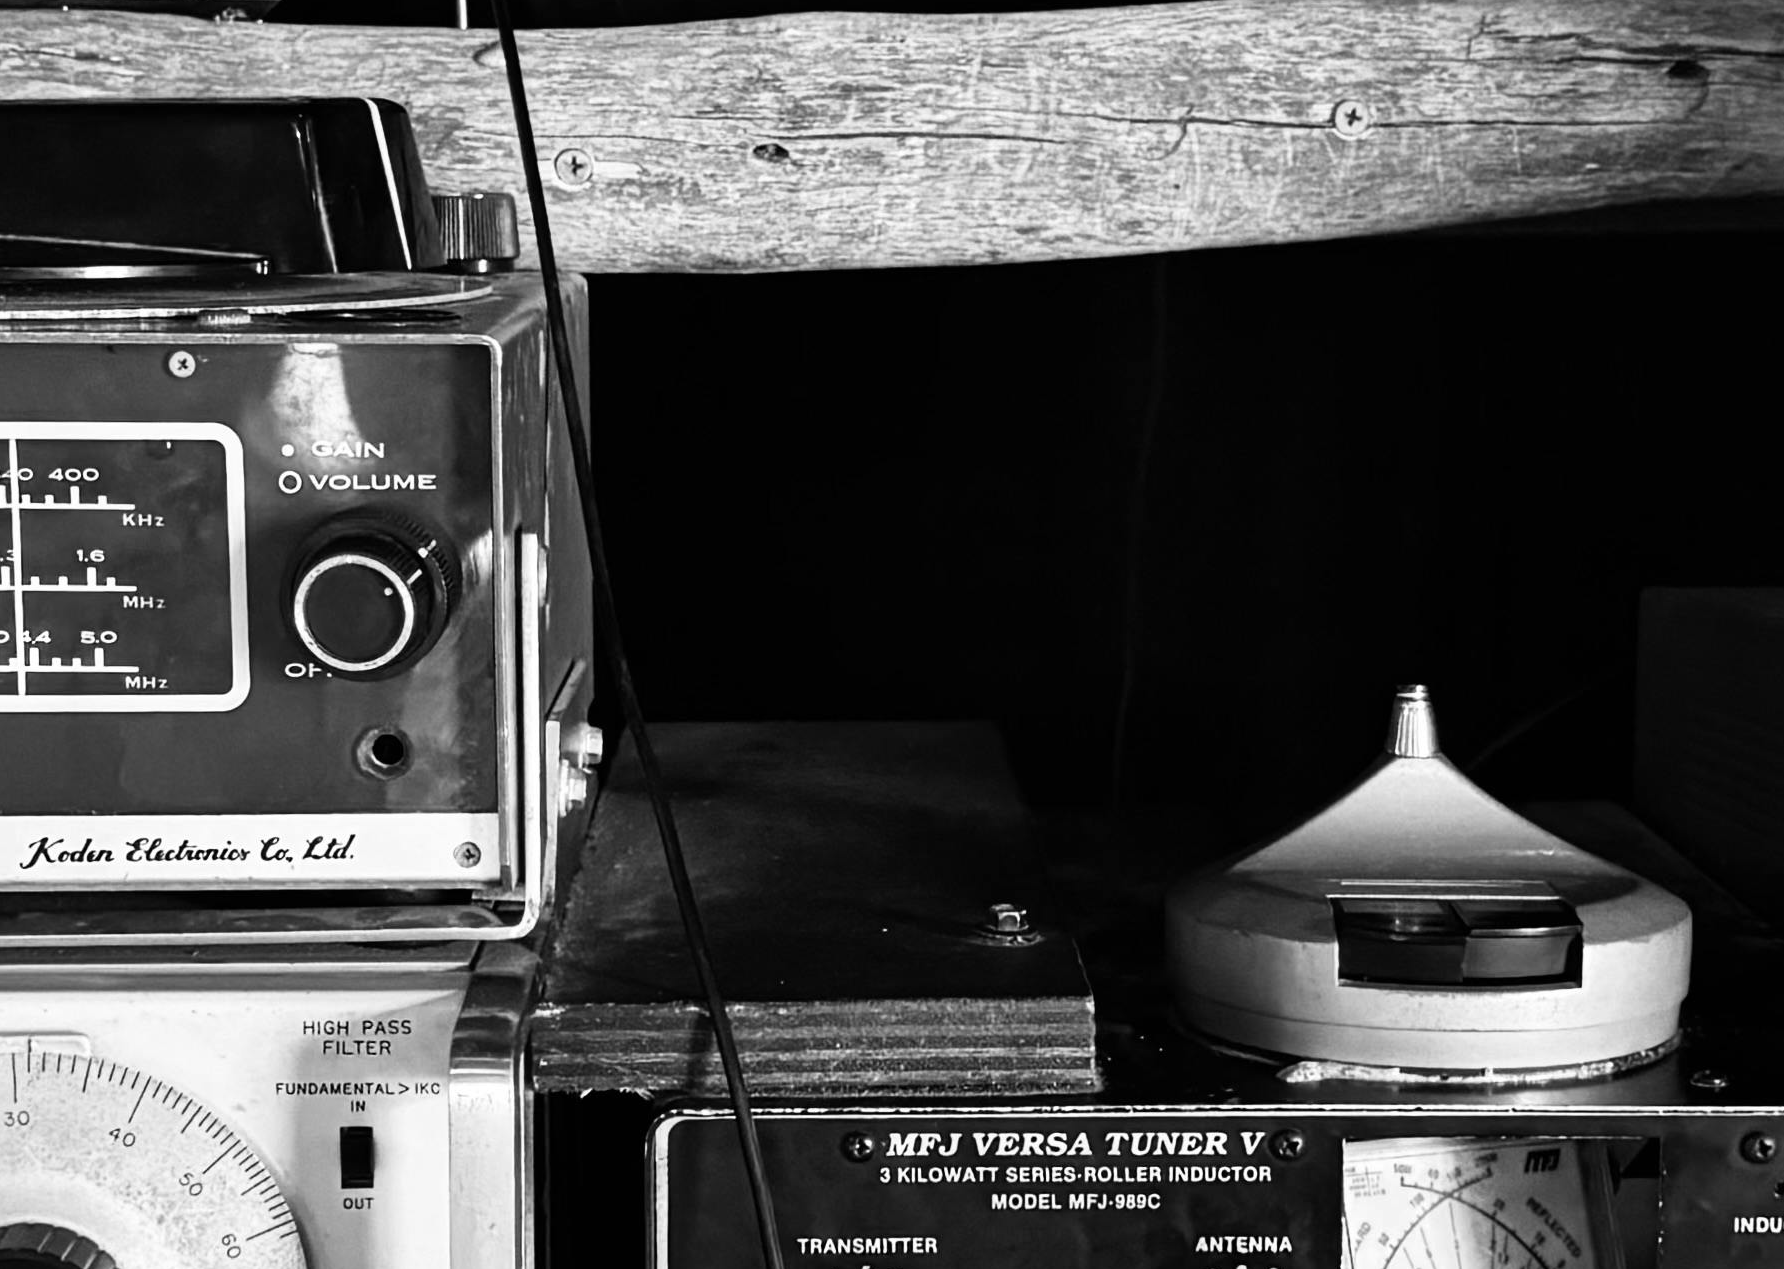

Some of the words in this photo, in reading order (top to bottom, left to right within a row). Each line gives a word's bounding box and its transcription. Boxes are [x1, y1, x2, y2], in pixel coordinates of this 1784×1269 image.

[311, 441, 386, 459] GAIN
[49, 468, 99, 481] 400
[309, 474, 436, 490] VOLUME
[20, 837, 114, 869] Koden
[126, 838, 250, 861] Electronics
[303, 1021, 349, 1036] HIGH
[363, 1020, 411, 1035] PASS
[323, 1040, 391, 1055] FILTER
[886, 1133, 962, 1156] MFJ
[973, 1133, 1092, 1156] VERSA
[1106, 1132, 1225, 1155] TUNER
[1241, 1132, 1265, 1155] V
[880, 1168, 890, 1183] 3
[898, 1167, 998, 1182] KILOWATT
[1169, 1166, 1271, 1182] INDUCTOR
[992, 1194, 1061, 1209] MODEL
[797, 1238, 937, 1254] TRANSMITTER
[1196, 1237, 1292, 1253] ANTENNA
